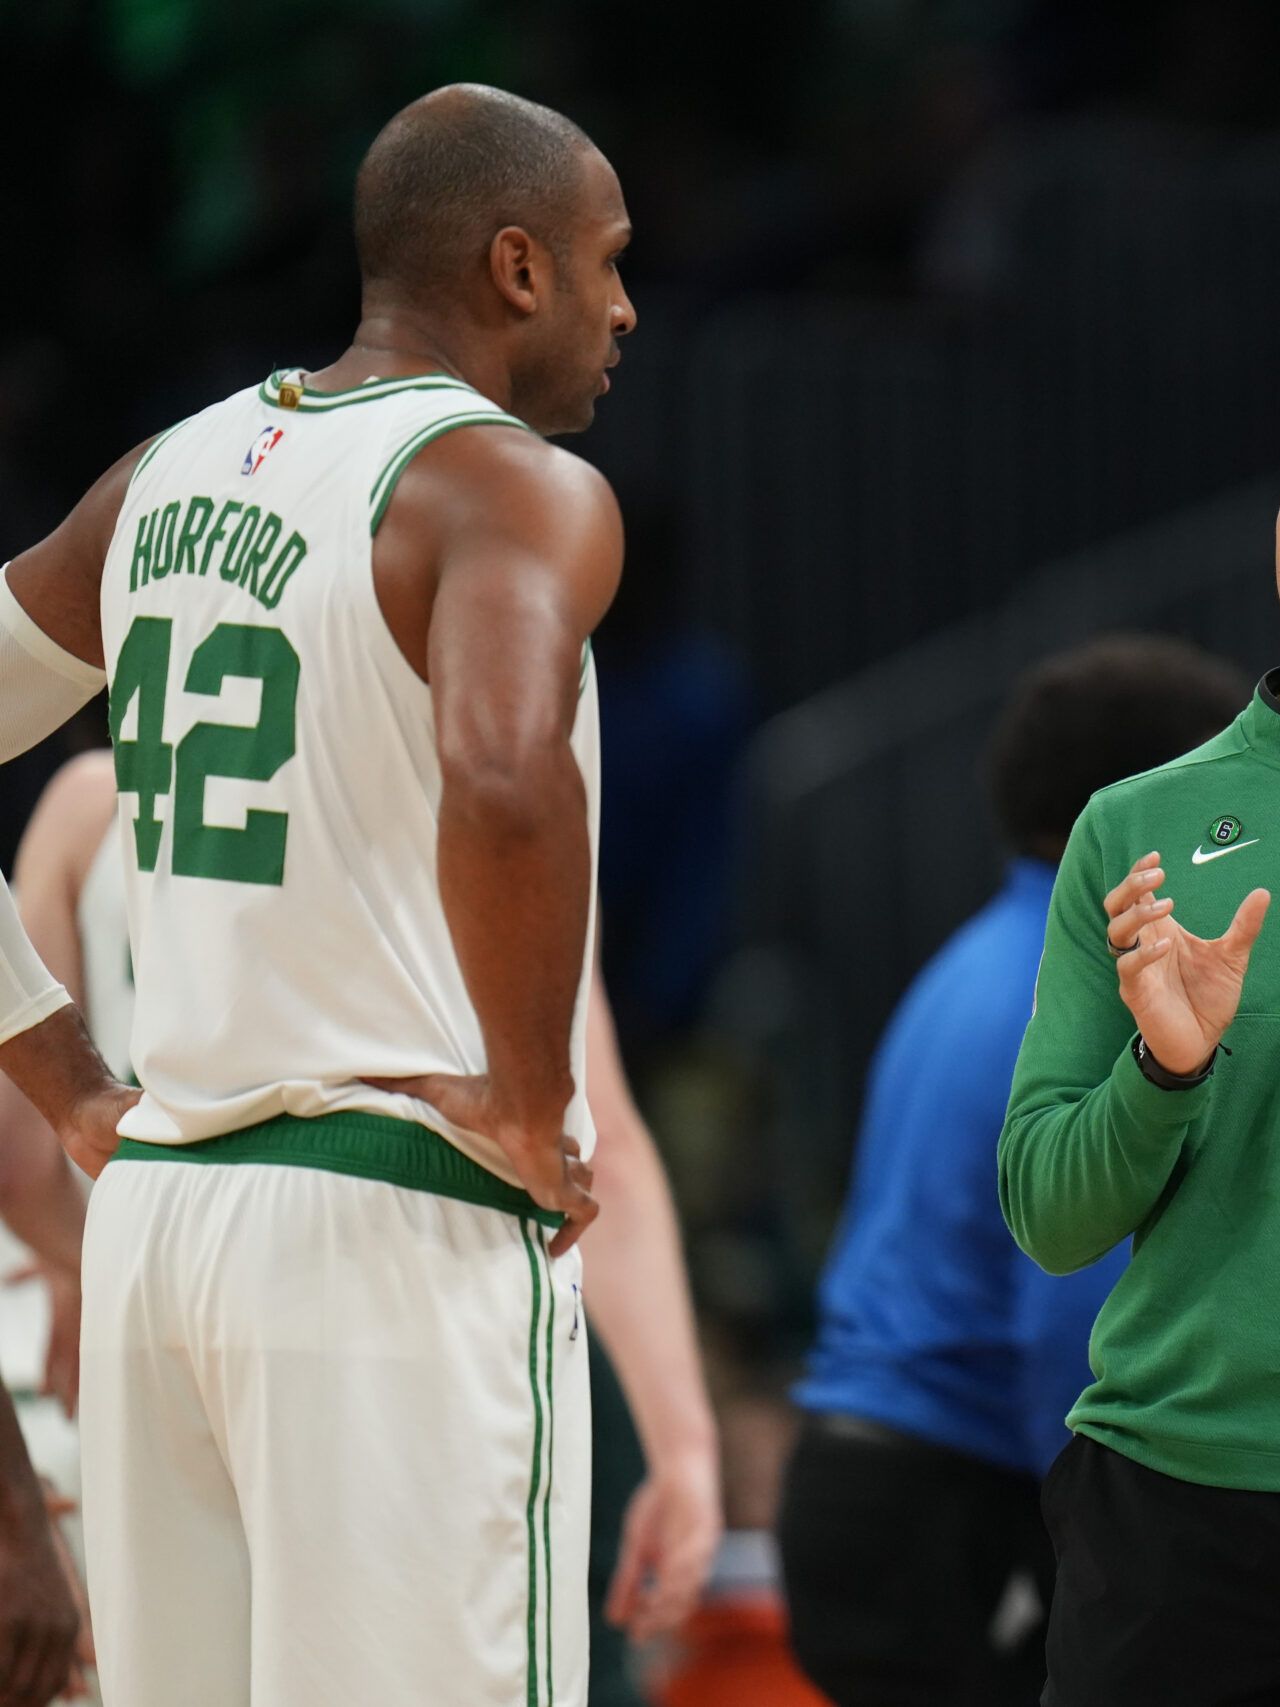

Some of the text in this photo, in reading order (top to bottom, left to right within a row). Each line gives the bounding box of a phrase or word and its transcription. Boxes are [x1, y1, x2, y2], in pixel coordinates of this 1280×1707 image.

[129, 495, 307, 610] HORFORD
[109, 616, 300, 886] 42
[1216, 820, 1234, 840] 6
